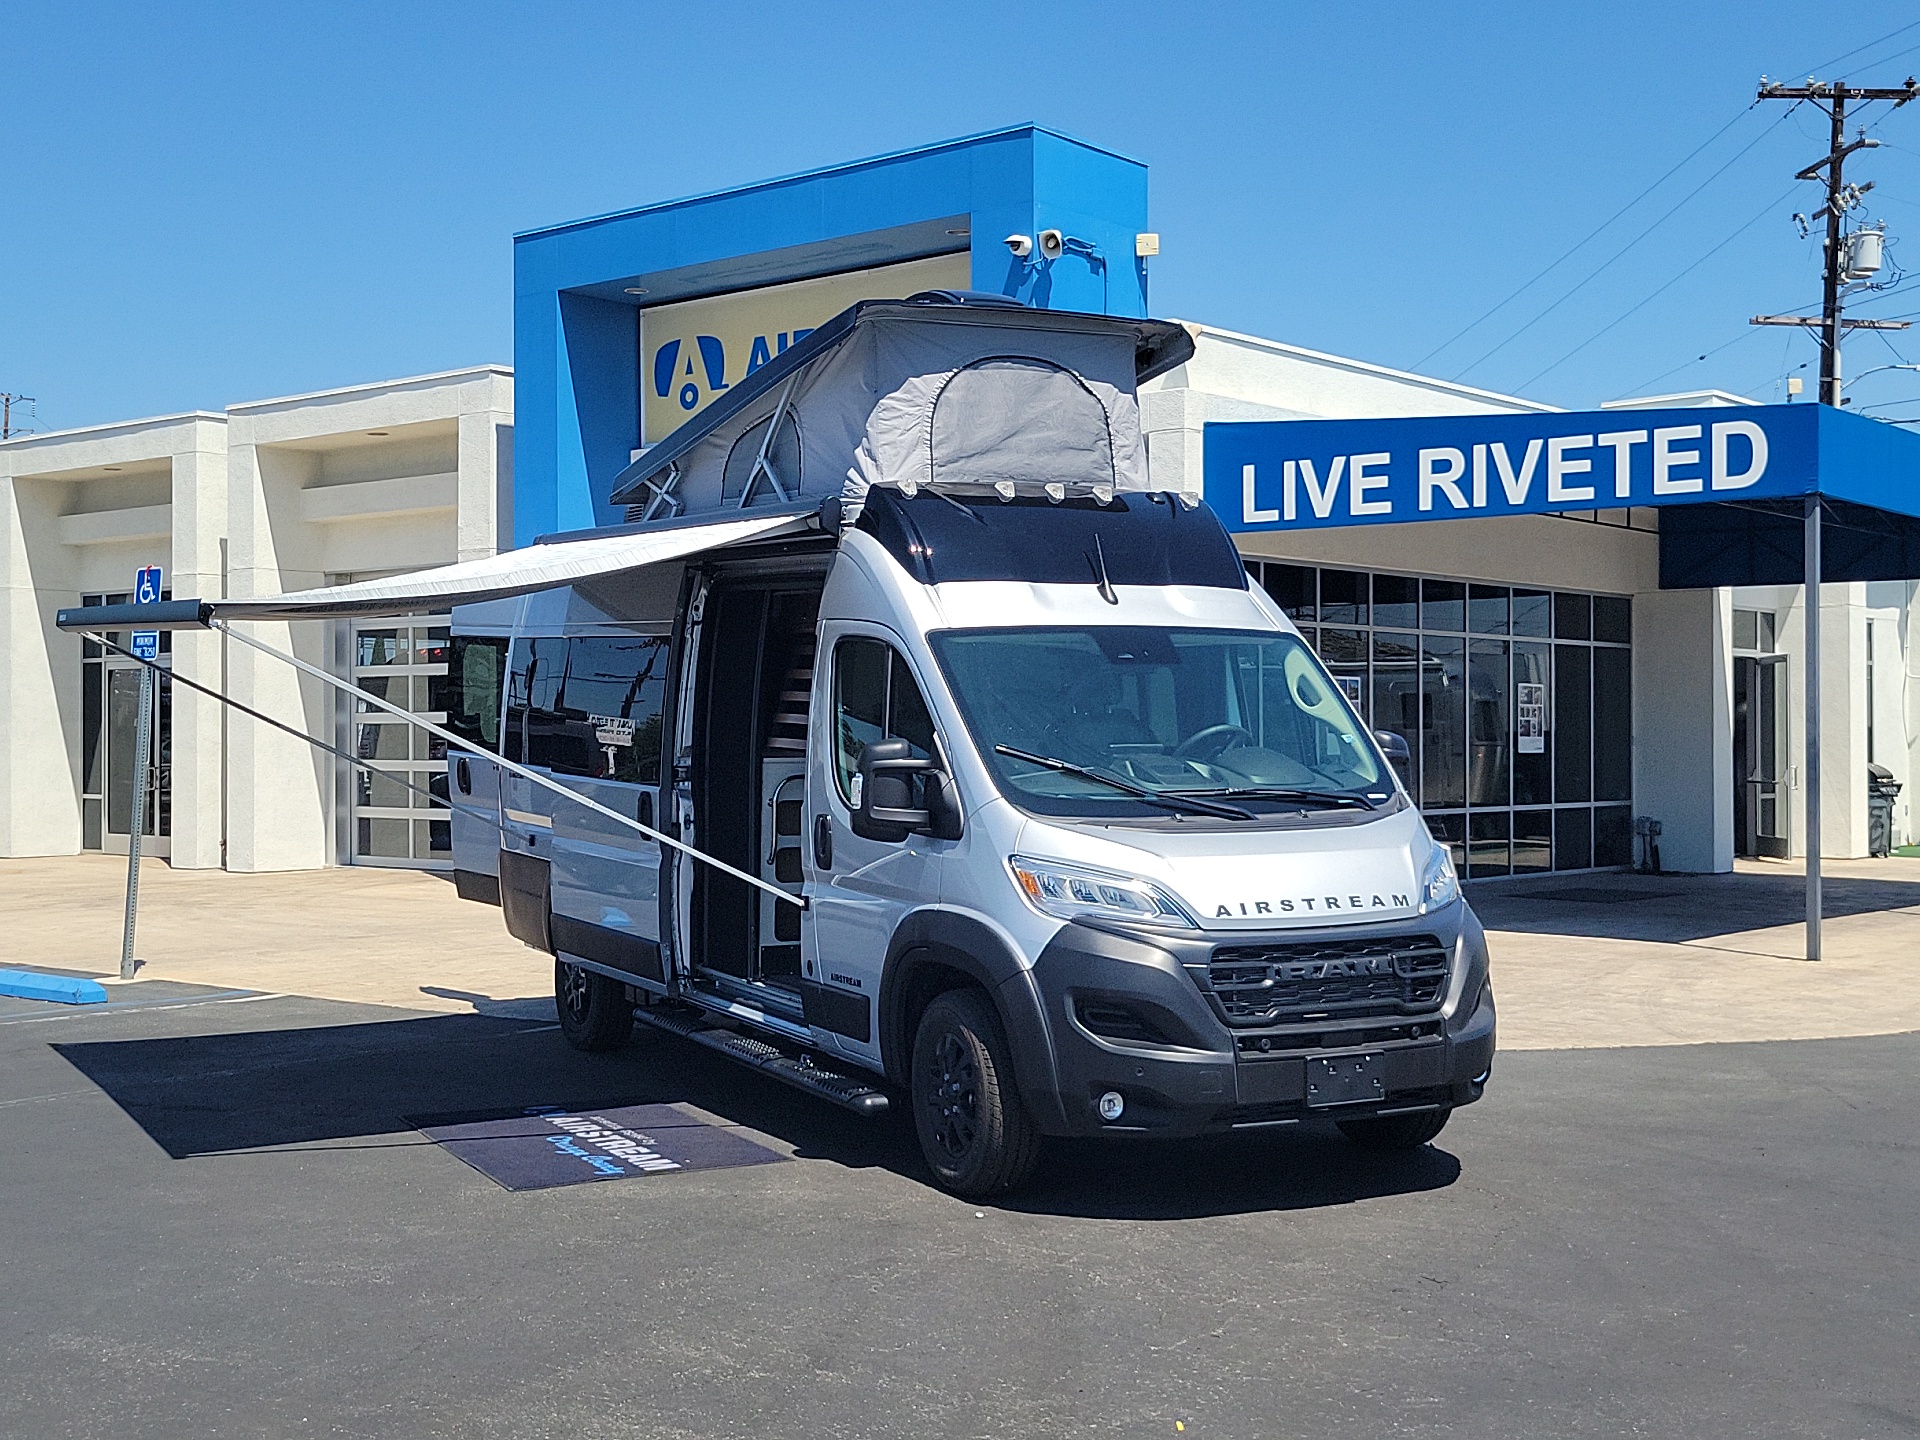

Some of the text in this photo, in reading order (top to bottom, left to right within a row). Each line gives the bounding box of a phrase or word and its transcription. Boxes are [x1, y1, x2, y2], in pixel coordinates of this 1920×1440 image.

[1243, 420, 1768, 523] LIVE RIVETED
[1215, 893, 1411, 917] AIRSTREAM
[1286, 956, 1388, 981] RAM
[545, 1116, 682, 1171] AIRSTREAM
